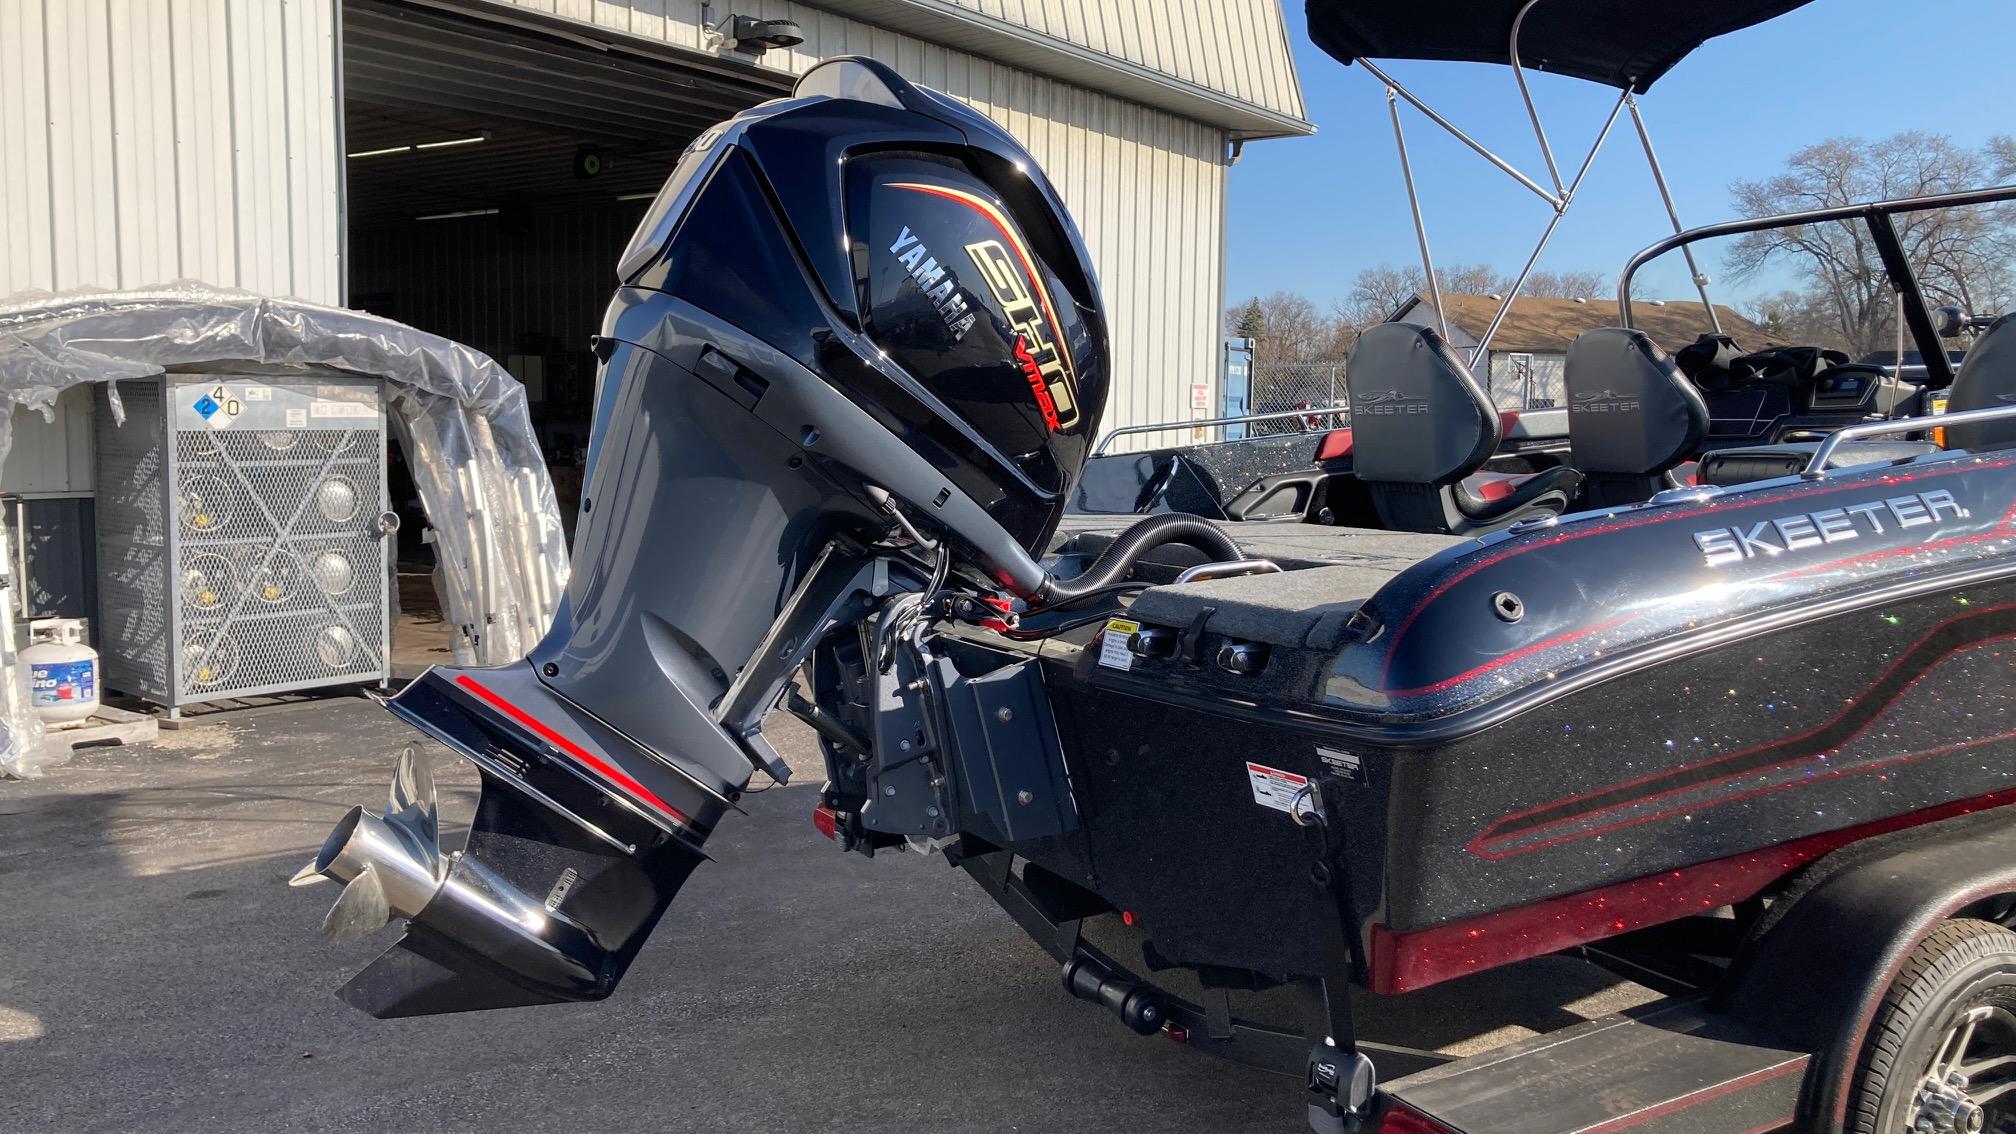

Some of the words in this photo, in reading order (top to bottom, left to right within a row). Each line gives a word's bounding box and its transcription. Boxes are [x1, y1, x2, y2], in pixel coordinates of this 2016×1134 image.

[889, 225, 977, 341] YAMAHA
[213, 386, 225, 402] 4
[201, 398, 211, 415] 2
[1354, 403, 1429, 415] SKEETER
[1572, 401, 1640, 413] SKEETER
